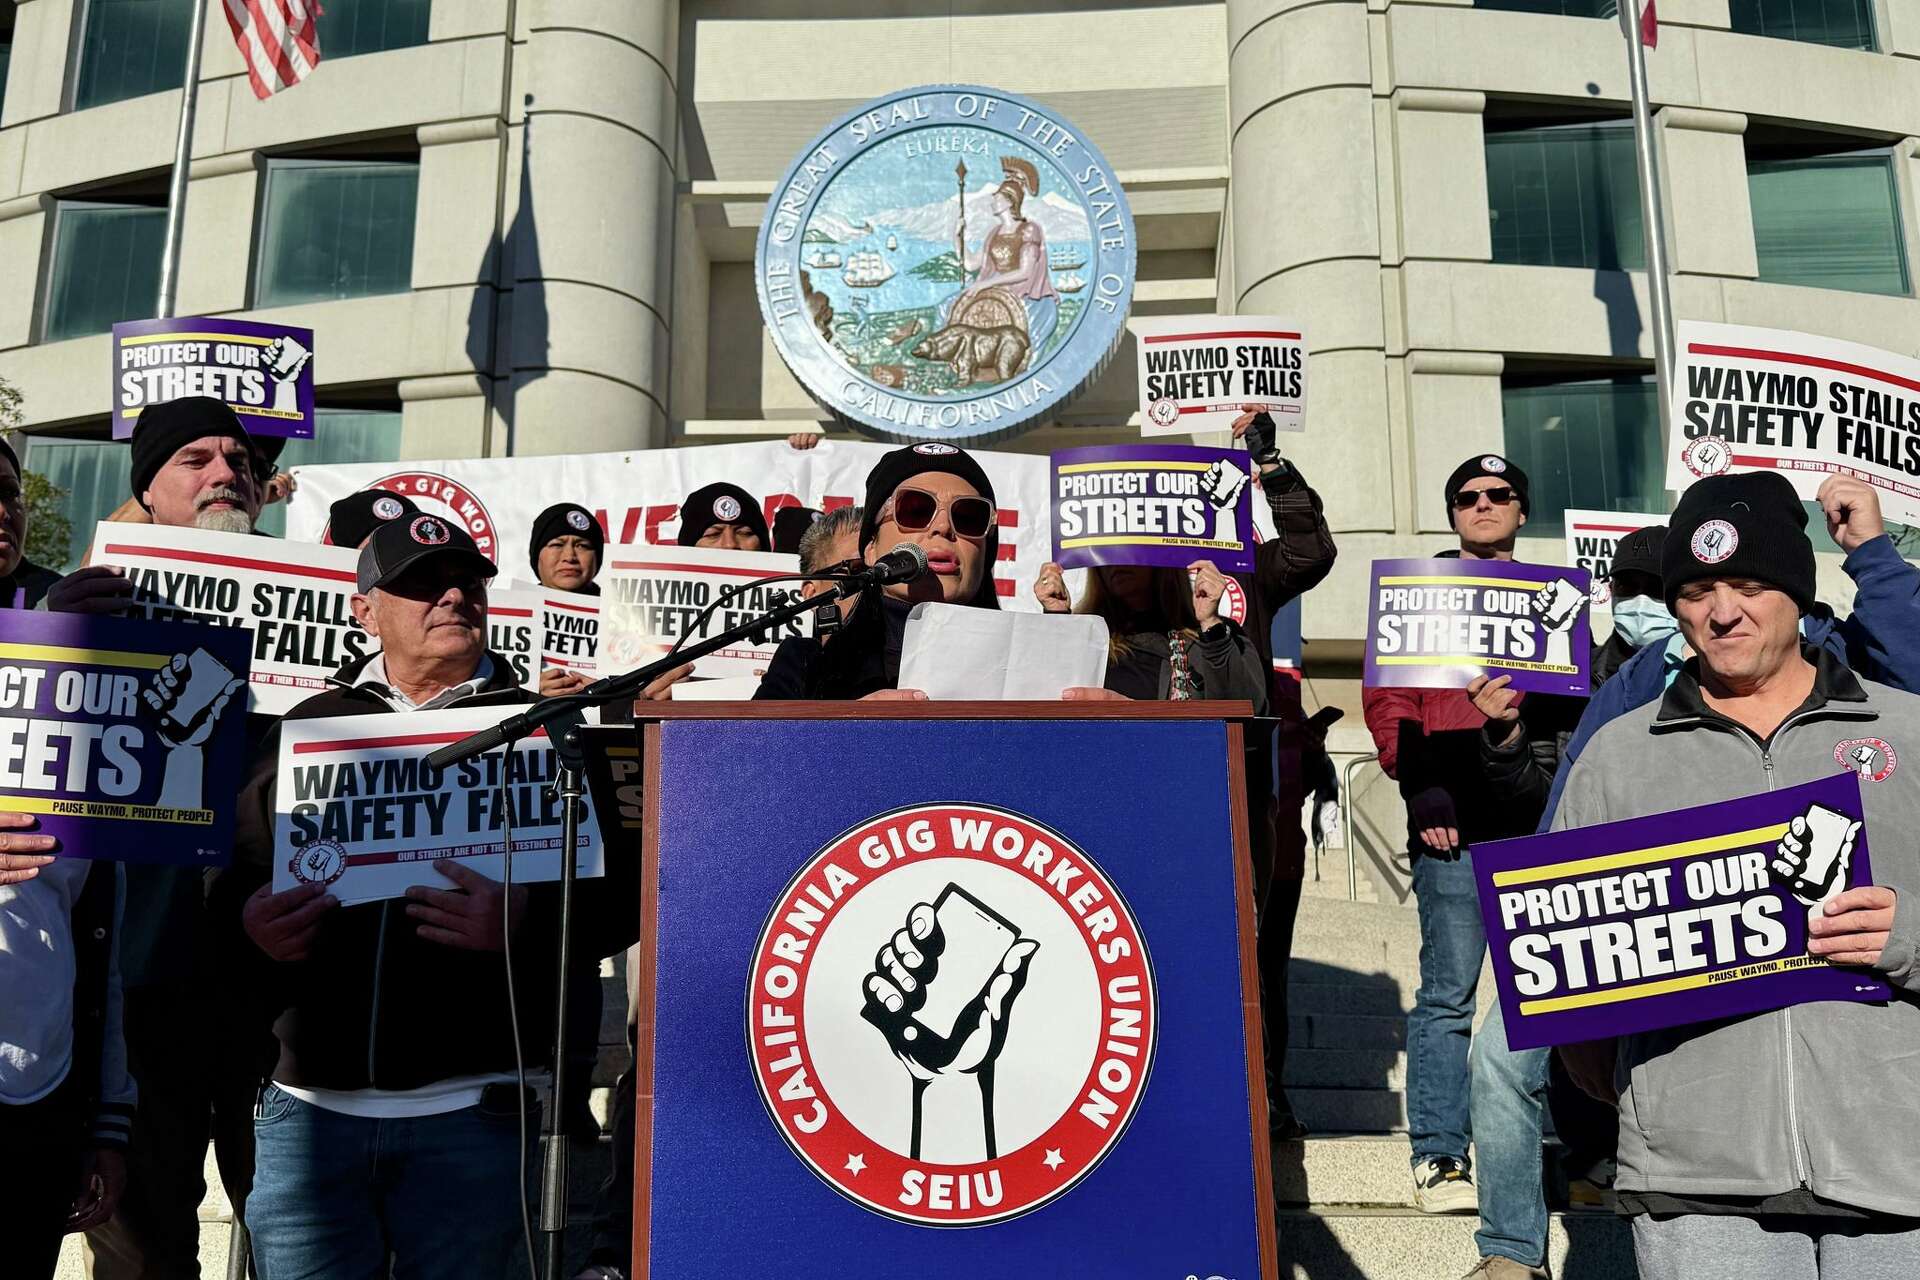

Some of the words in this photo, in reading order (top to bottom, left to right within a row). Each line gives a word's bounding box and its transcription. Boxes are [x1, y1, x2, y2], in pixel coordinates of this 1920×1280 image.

[849, 97, 929, 144] SEAL
[954, 94, 998, 121] OF
[904, 135, 991, 159] EUREKA
[1015, 107, 1074, 158] THE
[773, 144, 839, 243] GREAT
[1076, 165, 1125, 252] STATE
[768, 259, 798, 327] THE
[1094, 273, 1124, 314] OF
[121, 343, 210, 369] PROTECT
[215, 343, 260, 368] OUR
[1145, 346, 1229, 373] WAYMO
[1236, 345, 1301, 370] STALLS
[121, 366, 266, 407] STREETS
[839, 373, 1053, 429] CALIFORNIA
[1147, 370, 1234, 402] SAFETY
[1242, 370, 1301, 398] FALLS
[1687, 366, 1818, 409] WAYMO
[1829, 381, 1920, 436] STALLS
[1683, 400, 1825, 449] SAFETY
[1837, 416, 1920, 477] FALLS
[1059, 472, 1150, 498] PROTECT
[1155, 472, 1199, 497] OUR
[415, 478, 456, 504] GIG
[460, 499, 492, 559] WOR
[1059, 497, 1206, 537] STREETS
[611, 577, 710, 606] WAYMO
[1379, 588, 1477, 611] PROTECT
[1483, 589, 1530, 615] OUR
[608, 605, 714, 639] SAFETY
[1377, 614, 1536, 658] STREETS
[55, 670, 139, 717] OUR
[293, 754, 444, 801] WAYMO
[52, 801, 84, 815] PAUSE
[132, 806, 175, 821] PROTECT
[177, 809, 213, 823] PEOPLE
[290, 792, 452, 847] SAFETY
[398, 850, 416, 863] OUR
[417, 848, 451, 861] STREETS
[453, 846, 470, 857] ARE
[471, 844, 488, 855] NOT
[515, 839, 548, 850] TESTING
[1499, 867, 1671, 930] PROTECT
[1684, 851, 1770, 900] OUR
[1508, 896, 1788, 996] STREETS
[761, 862, 859, 1136] CALIFORNIA
[858, 818, 937, 869] GIG
[949, 816, 1132, 965] WORKERS
[1078, 974, 1143, 1130] UNION
[1708, 970, 1739, 983] PAUSE
[898, 1168, 1004, 1211] SEIU
